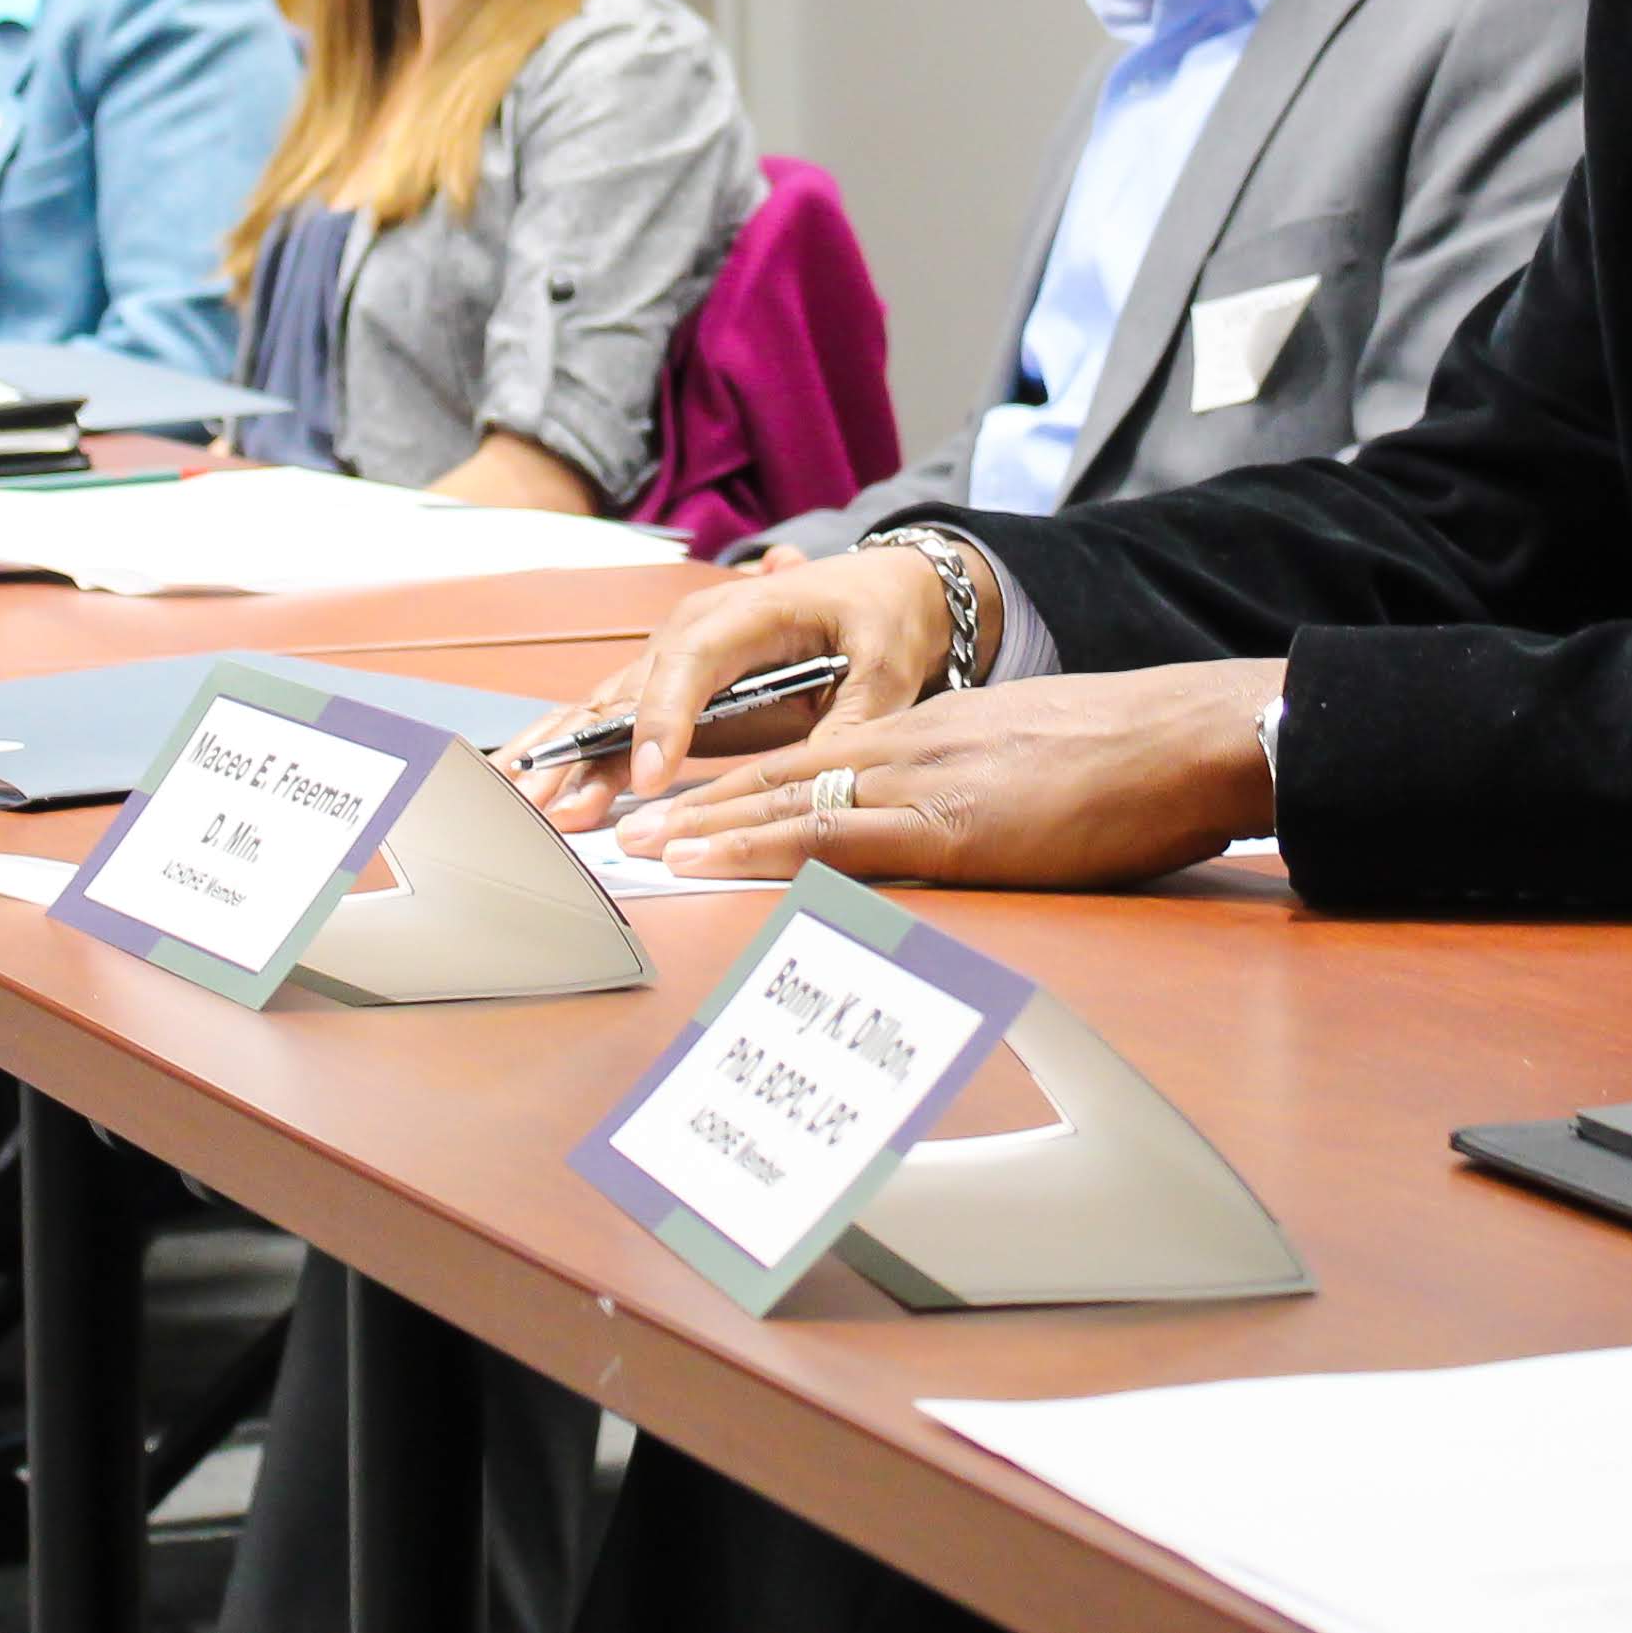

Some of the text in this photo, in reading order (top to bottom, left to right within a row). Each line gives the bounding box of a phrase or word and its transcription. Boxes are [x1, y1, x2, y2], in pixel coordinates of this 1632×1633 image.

[188, 731, 363, 828] Maceo E. Freeman,
[201, 813, 262, 863] D. Min.
[763, 957, 916, 1083] Bonny K. Dillon,
